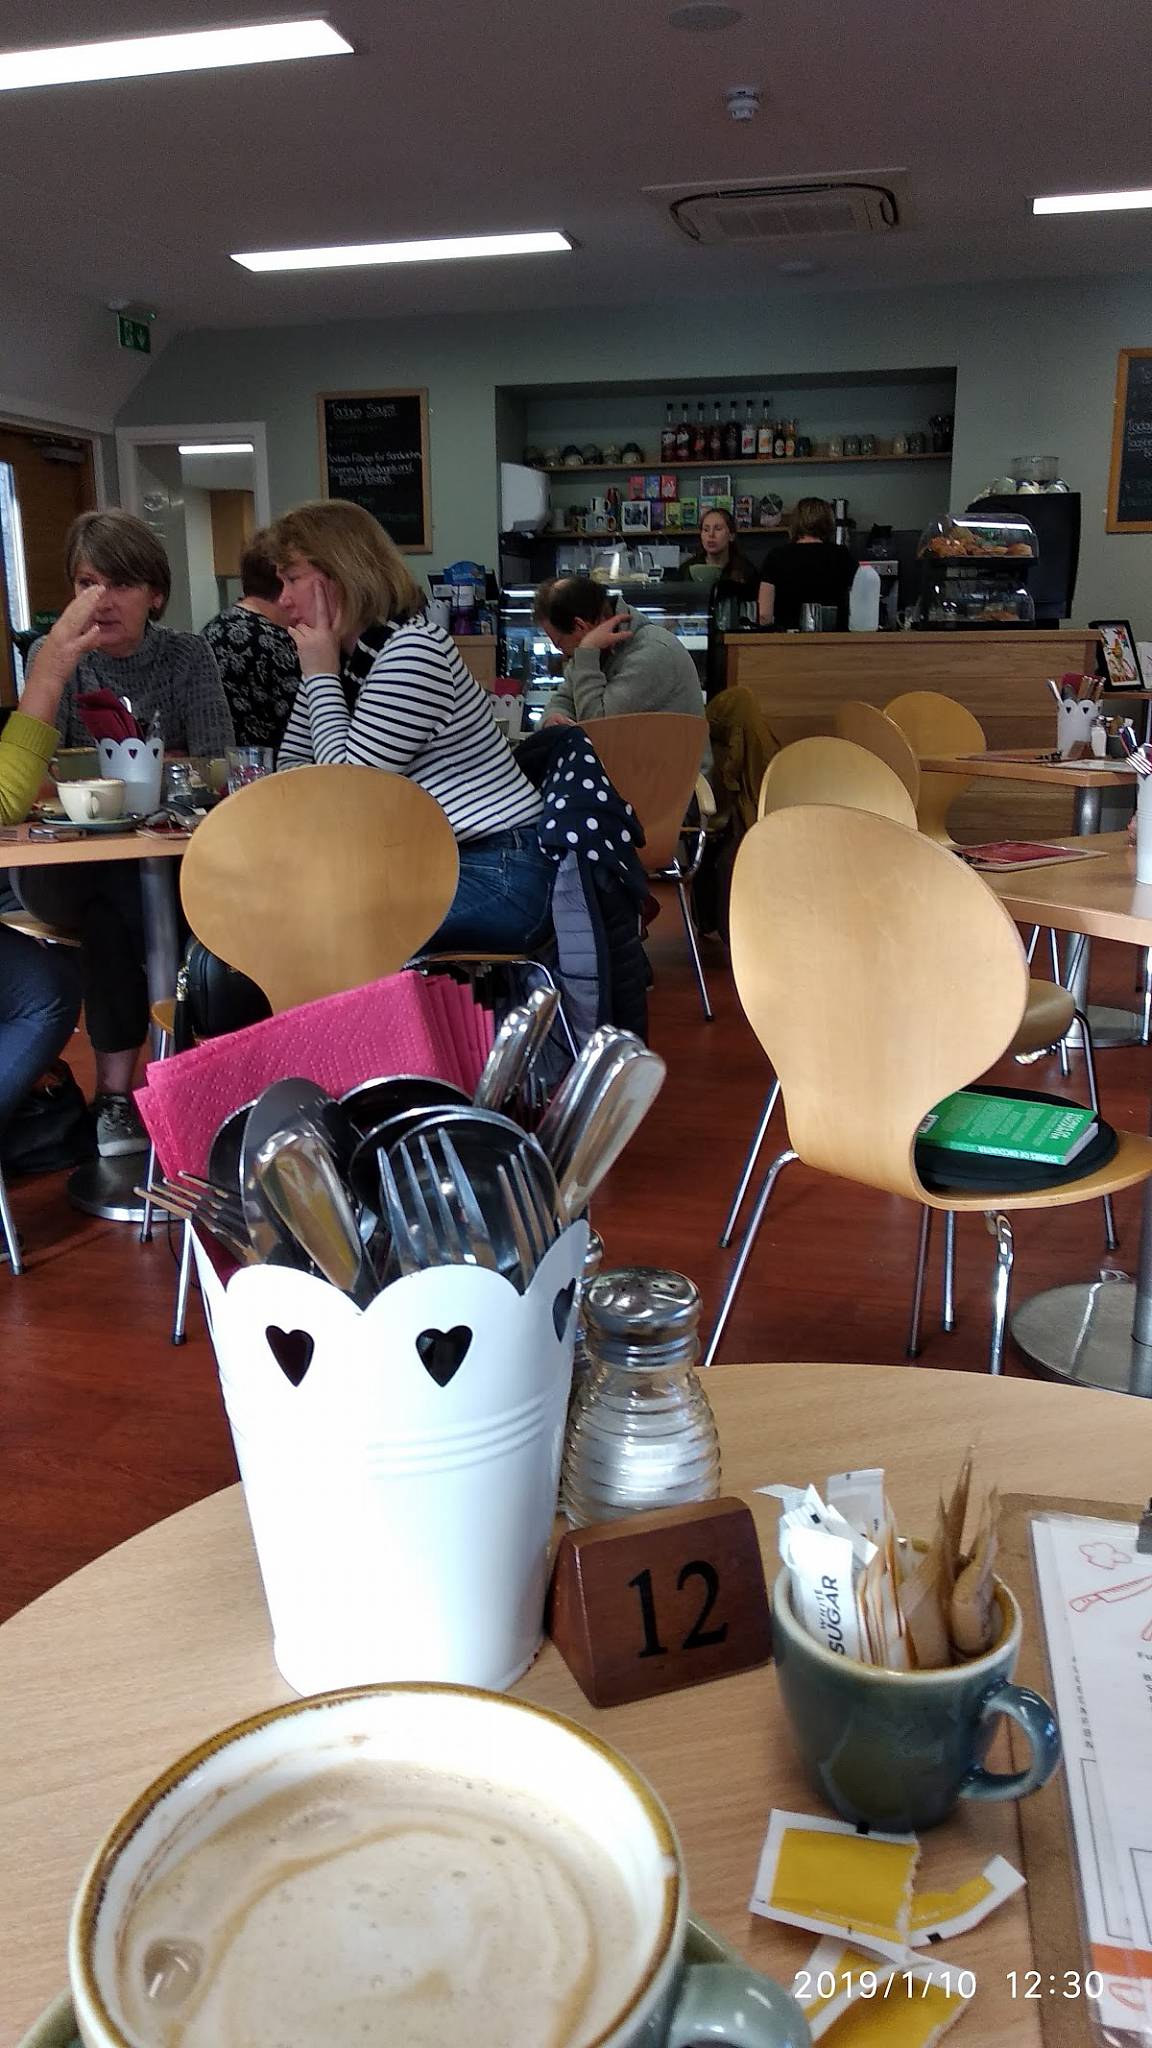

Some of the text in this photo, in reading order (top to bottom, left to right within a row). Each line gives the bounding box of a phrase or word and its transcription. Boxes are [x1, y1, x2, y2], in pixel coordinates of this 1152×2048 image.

[627, 1560, 729, 1659] 12
[814, 1588, 827, 1630] WHITE
[821, 1575, 846, 1656] SUGAR
